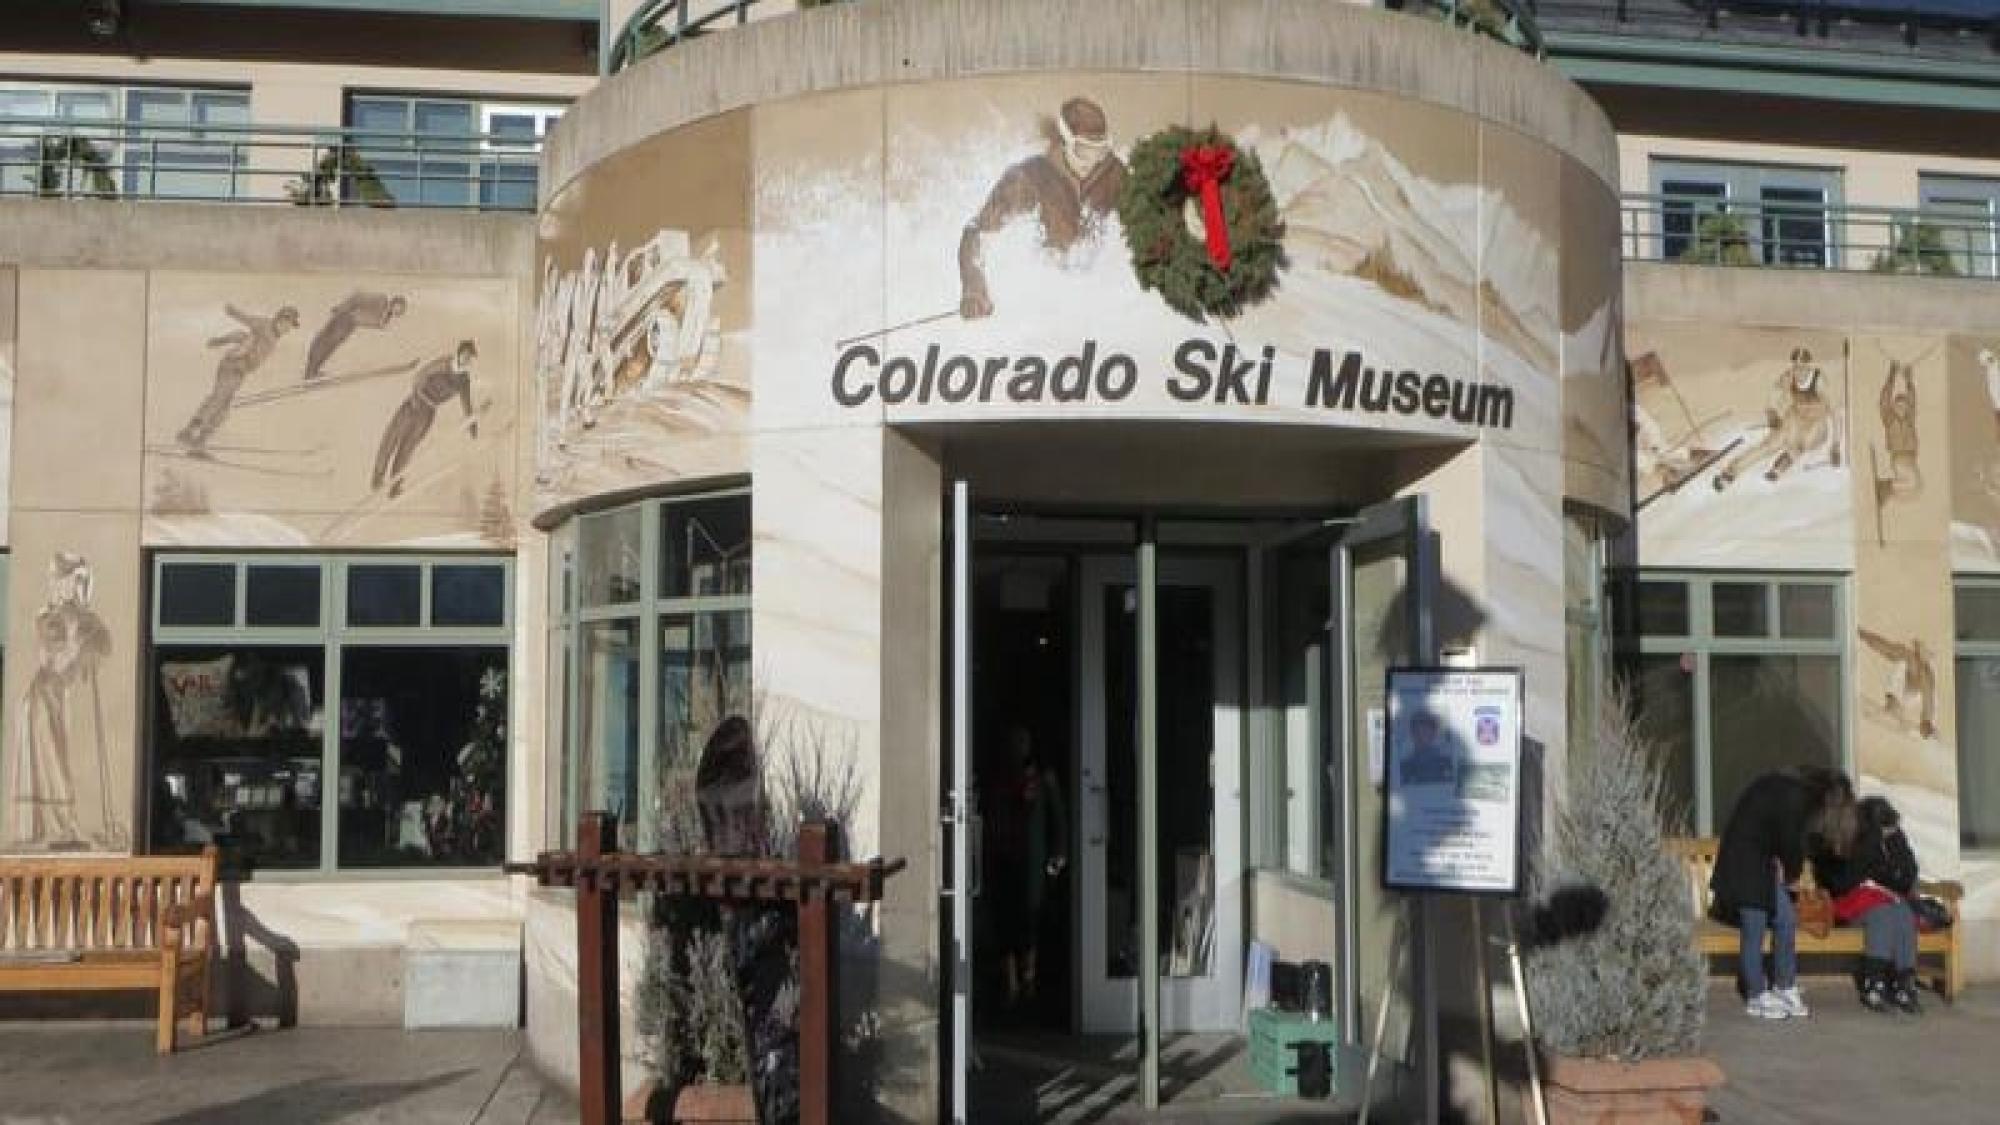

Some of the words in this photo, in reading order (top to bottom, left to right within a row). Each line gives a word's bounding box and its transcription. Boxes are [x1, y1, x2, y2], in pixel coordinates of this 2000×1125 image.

[831, 339, 1138, 408] Colorado
[1166, 339, 1276, 406] Ski
[1305, 348, 1515, 429] Museum
